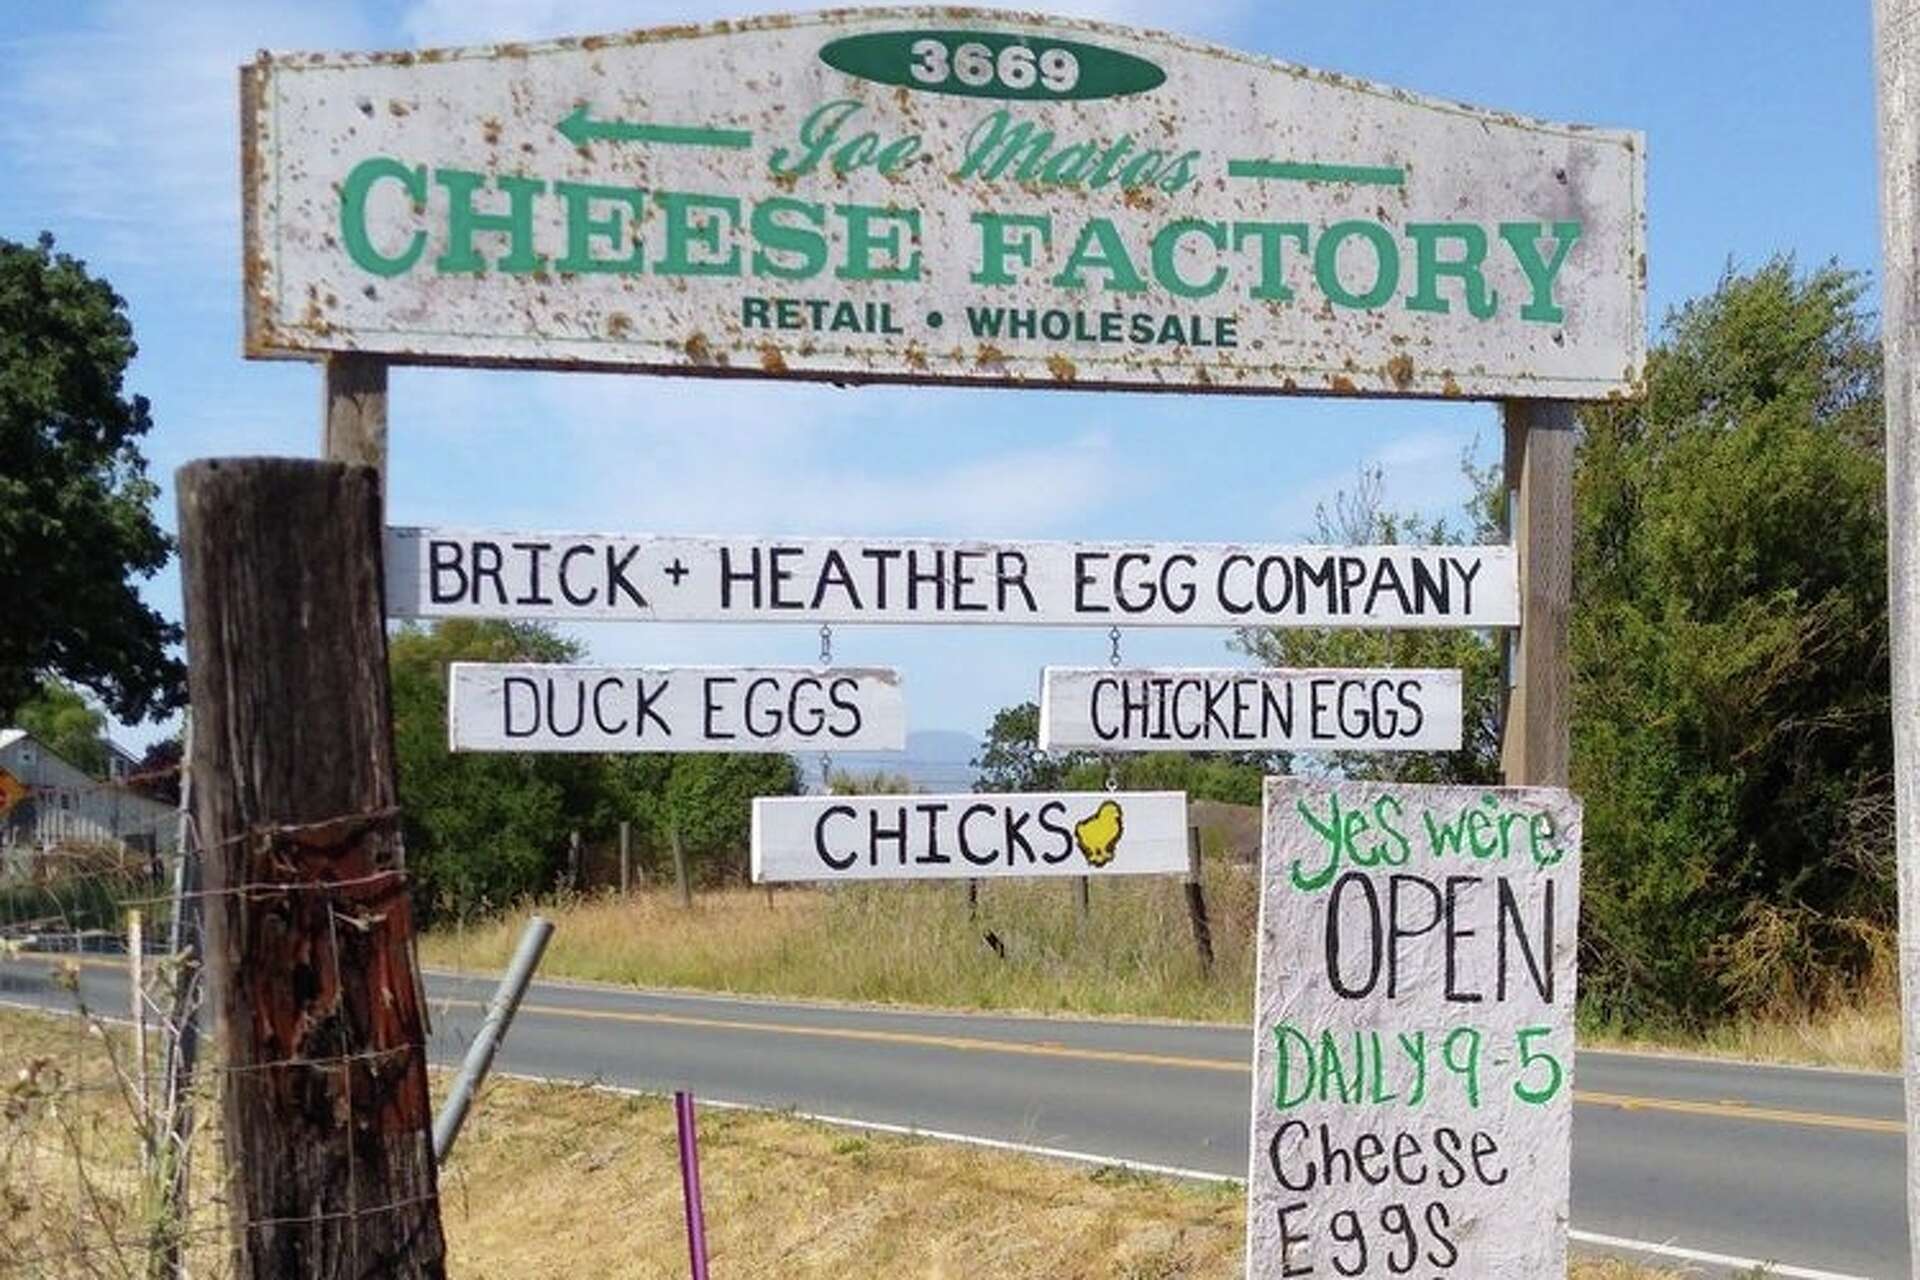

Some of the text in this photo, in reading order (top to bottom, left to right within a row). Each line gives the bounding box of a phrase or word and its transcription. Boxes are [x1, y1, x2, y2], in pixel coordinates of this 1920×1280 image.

[911, 39, 1080, 93] 3669
[769, 100, 1202, 196] Joe Matos
[339, 157, 1582, 325] CHEESE FACTORY
[741, 297, 1239, 348] RETAIL WHOLESALE
[428, 540, 1483, 616] BRICK + HEATHER EGG COMPANY
[503, 676, 863, 740] DUCK EGGS
[1090, 679, 1424, 741] CHICKEN EGGS
[814, 800, 1075, 872] CHICKS
[1325, 870, 1555, 1004] OPEN
[1273, 1025, 1427, 1111] DAILY
[1269, 1119, 1509, 1192] Cheese
[1277, 1200, 1460, 1278] Eggs
